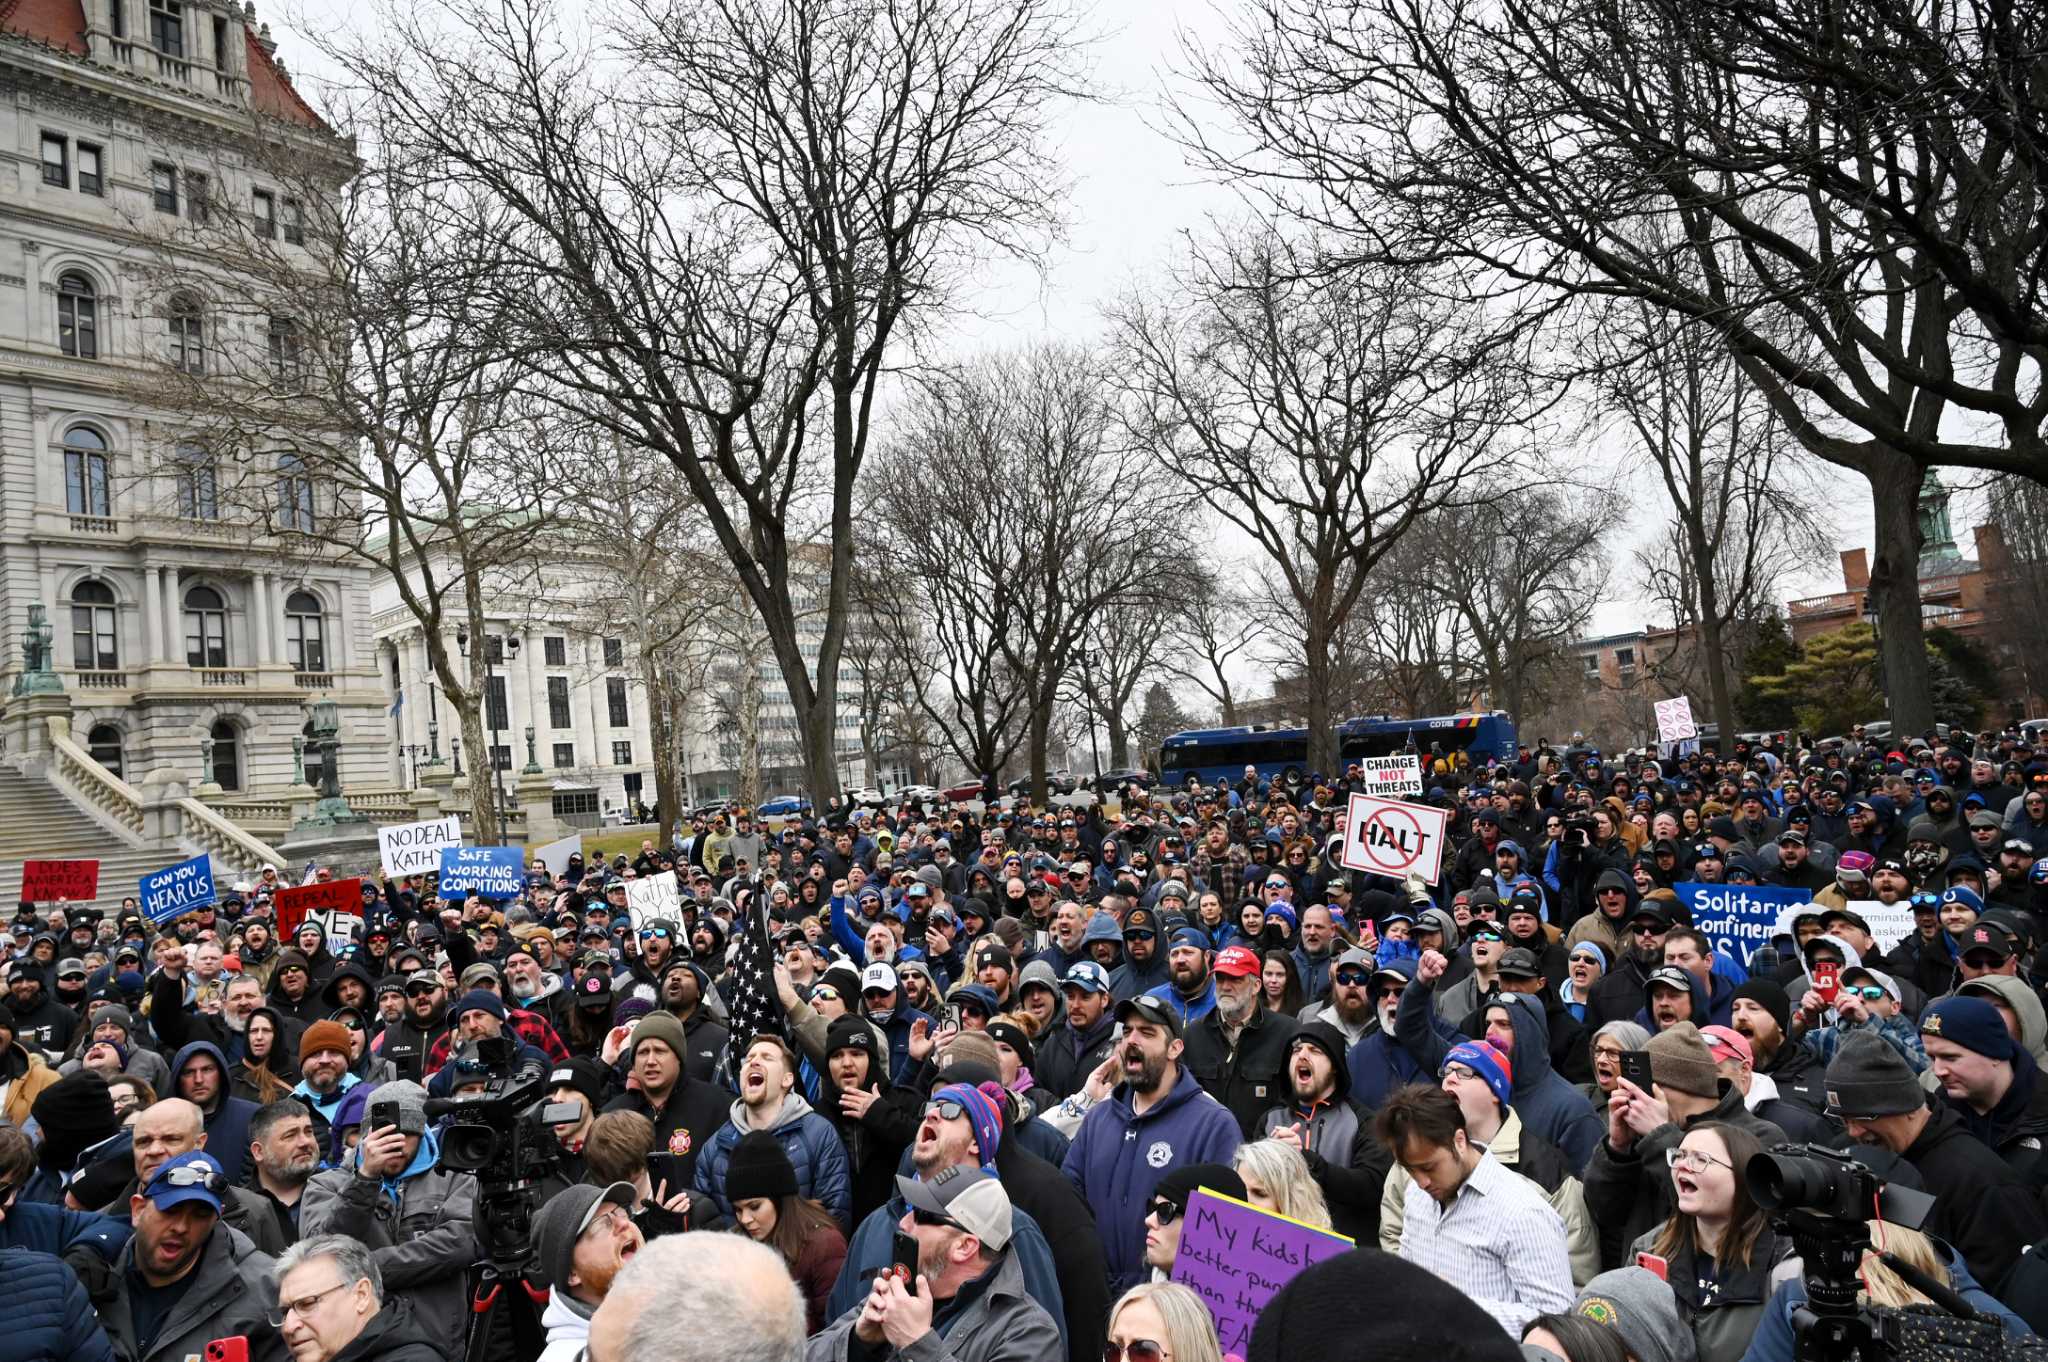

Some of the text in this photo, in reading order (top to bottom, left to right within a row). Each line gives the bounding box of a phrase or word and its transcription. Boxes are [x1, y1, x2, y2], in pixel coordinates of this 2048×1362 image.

[1366, 757, 1416, 771] CHANGE
[1379, 769, 1406, 781] NOT
[1368, 780, 1420, 794] THREATS
[387, 822, 460, 848] NO DEAL
[1358, 821, 1431, 855] HALT
[458, 849, 492, 861] SAFE
[39, 860, 81, 874] DOES
[447, 865, 512, 878] WORKING
[23, 874, 92, 886] AMERICA
[150, 865, 196, 889] CAN YOU
[441, 878, 520, 893] CONDITIONS
[148, 876, 209, 914] HEAR US
[283, 888, 344, 907] REPEAL
[628, 875, 678, 905] Kathy
[1863, 912, 1913, 922] rminate
[1195, 1208, 1237, 1250] My
[1252, 1226, 1298, 1265] kids
[1180, 1234, 1241, 1277] better
[1177, 1271, 1225, 1304] than
